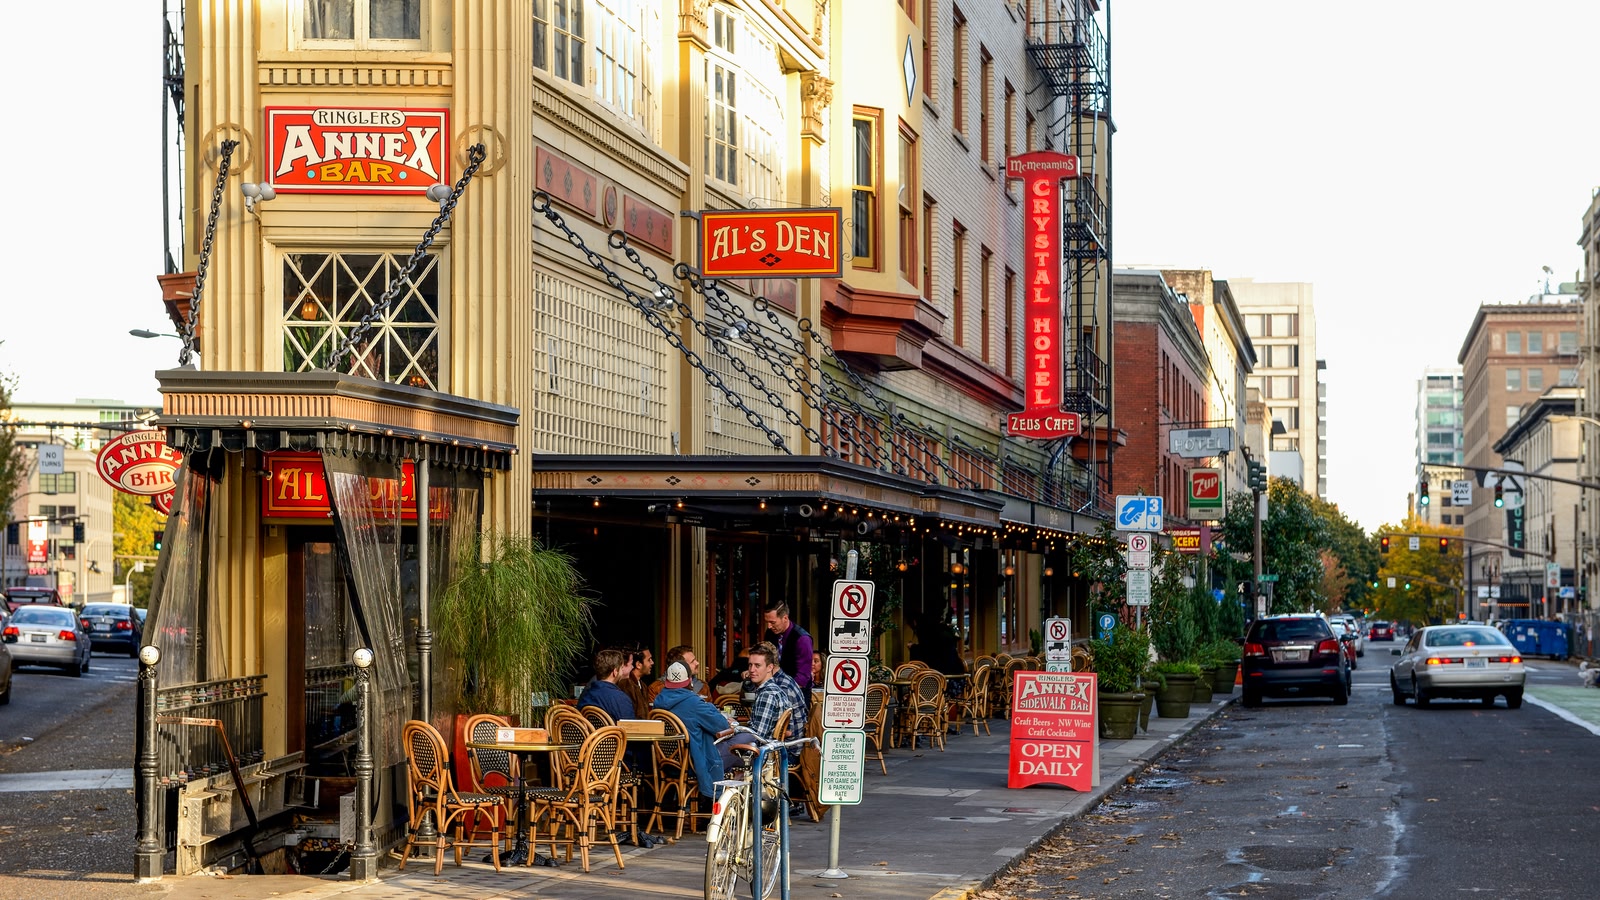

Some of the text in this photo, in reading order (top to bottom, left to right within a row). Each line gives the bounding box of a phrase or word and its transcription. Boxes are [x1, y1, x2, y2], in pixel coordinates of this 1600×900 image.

[318, 110, 402, 125] RINGLERS
[275, 125, 440, 181] ANNEX
[320, 161, 394, 183] BAR
[710, 220, 831, 262] AL'S DEN
[1032, 179, 1051, 303] CRYSTAL
[1033, 318, 1051, 405] HOTEL
[1011, 416, 1075, 431] ZEUS CAFE
[124, 432, 167, 445] RINGLER
[1174, 438, 1225, 451] HOTEL
[130, 470, 172, 487] BAR
[277, 467, 326, 500] AL'
[1194, 476, 1218, 496] 7UP
[1149, 498, 1159, 512] 3
[1172, 536, 1200, 547] OCERY
[1020, 680, 1090, 702] ANNEX
[1020, 697, 1089, 711] SIDEWALK BAR
[1014, 717, 1031, 725] Craft
[1058, 719, 1073, 727] NW
[1074, 719, 1091, 728] Wine
[1028, 728, 1076, 737] Craft Cocktails
[1021, 743, 1082, 759] OPEN
[1018, 760, 1083, 776] DAILY
